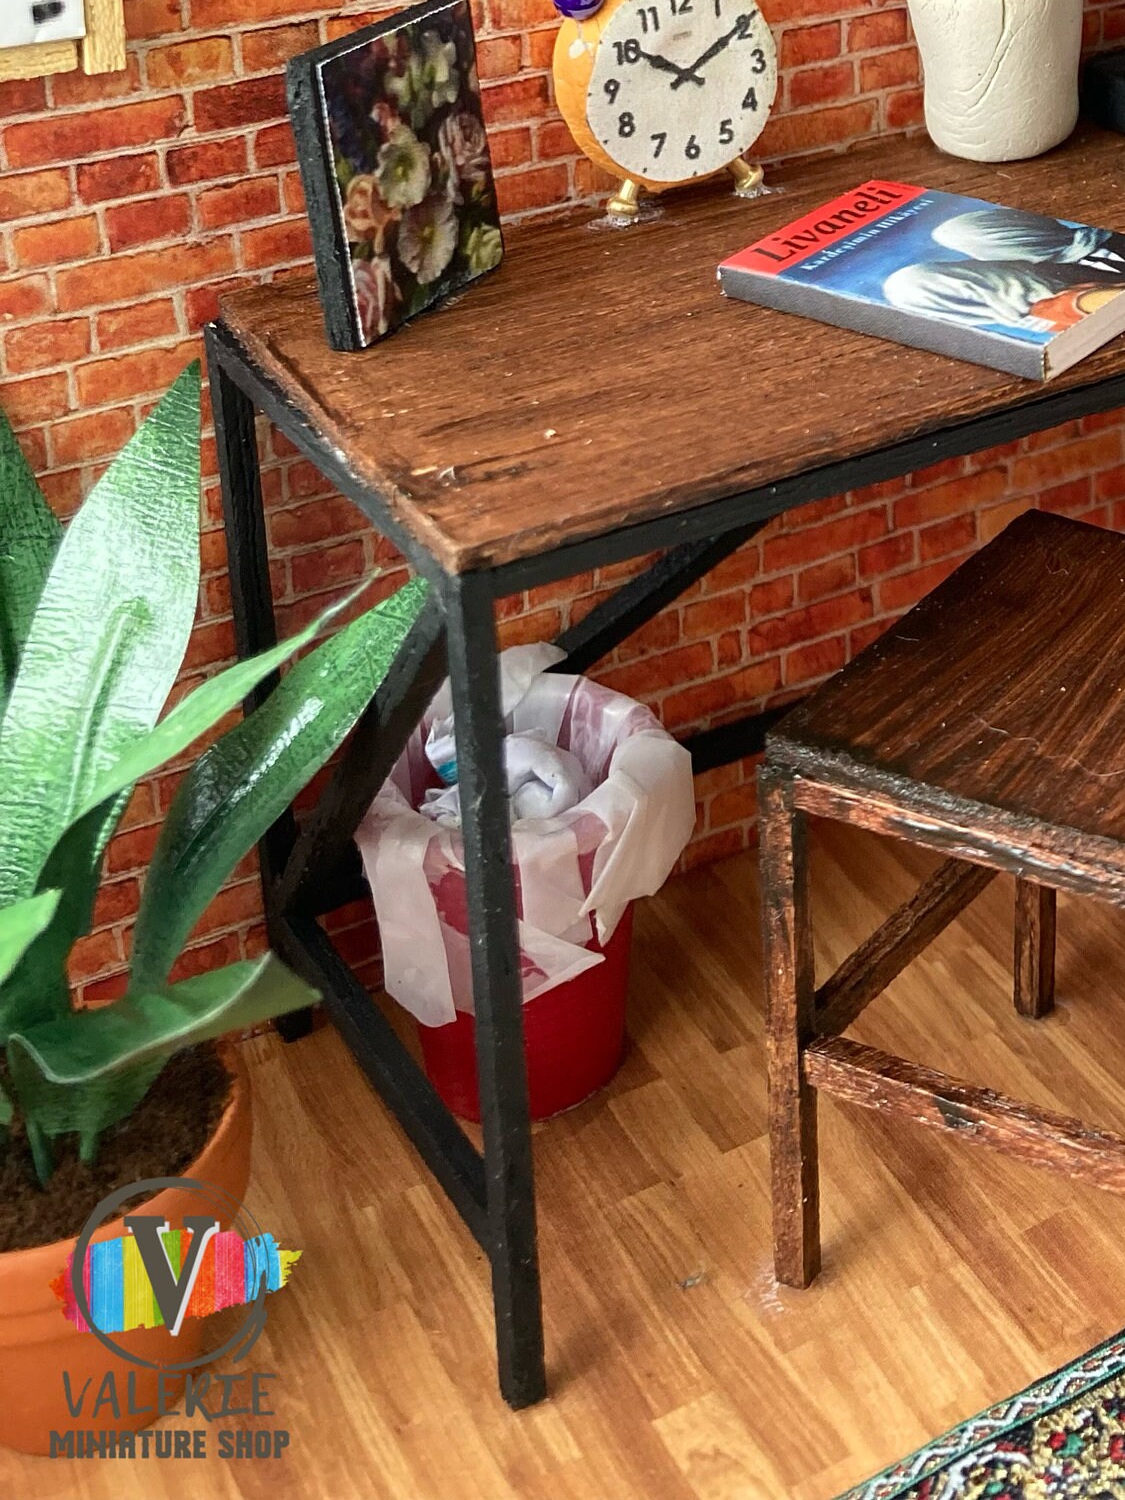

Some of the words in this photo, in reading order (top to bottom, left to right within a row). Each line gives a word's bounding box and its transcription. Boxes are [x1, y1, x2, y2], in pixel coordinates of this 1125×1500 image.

[636, 5, 661, 34] 11
[734, 13, 754, 41] 2
[612, 37, 642, 67] 10
[750, 48, 767, 74] 3
[603, 78, 621, 105] 9
[741, 86, 758, 112] 4
[617, 111, 636, 139] 8
[718, 118, 736, 145] 5
[650, 131, 667, 159] 7
[684, 134, 702, 160] 6
[752, 186, 903, 263] Livaneli
